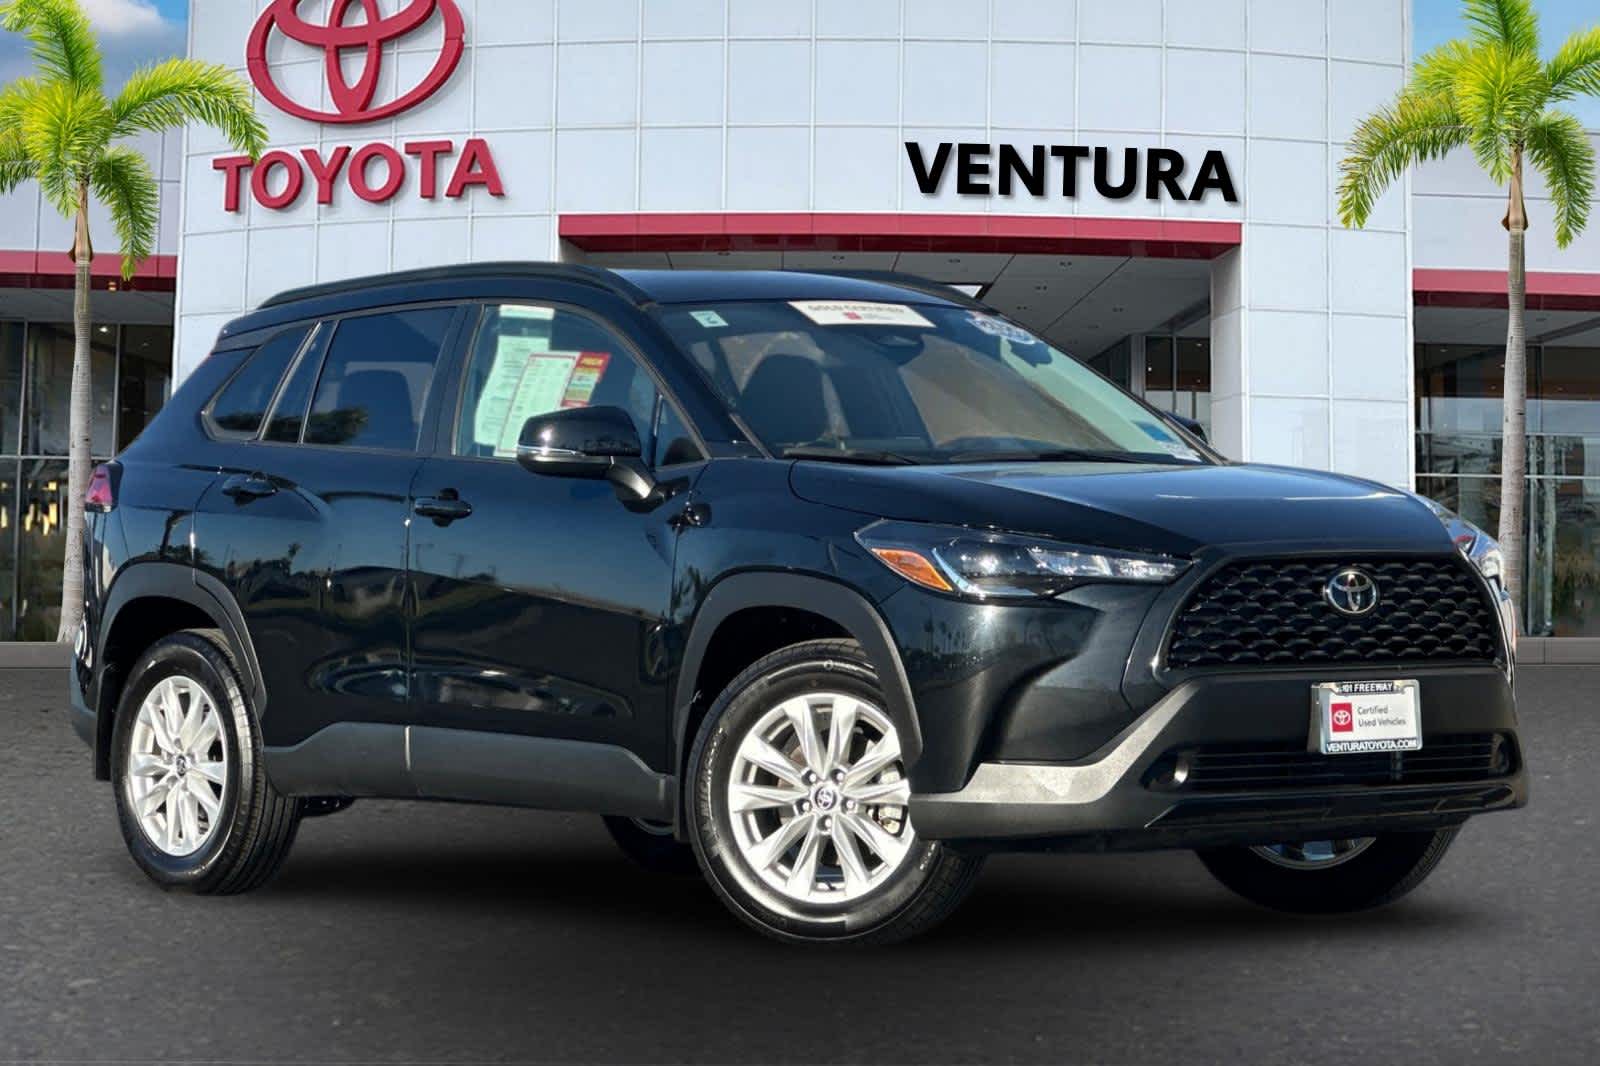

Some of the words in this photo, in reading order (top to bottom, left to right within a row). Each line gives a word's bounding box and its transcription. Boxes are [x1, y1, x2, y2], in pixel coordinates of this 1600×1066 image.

[213, 138, 505, 212] TOYOTA
[904, 142, 1238, 202] VENTURA
[1354, 682, 1393, 692] FREEWAY
[1357, 705, 1388, 715] Certified
[1358, 719, 1377, 728] Used
[1378, 717, 1407, 727] Vehicles
[1326, 739, 1417, 752] VENTURATOYOTA.COM
